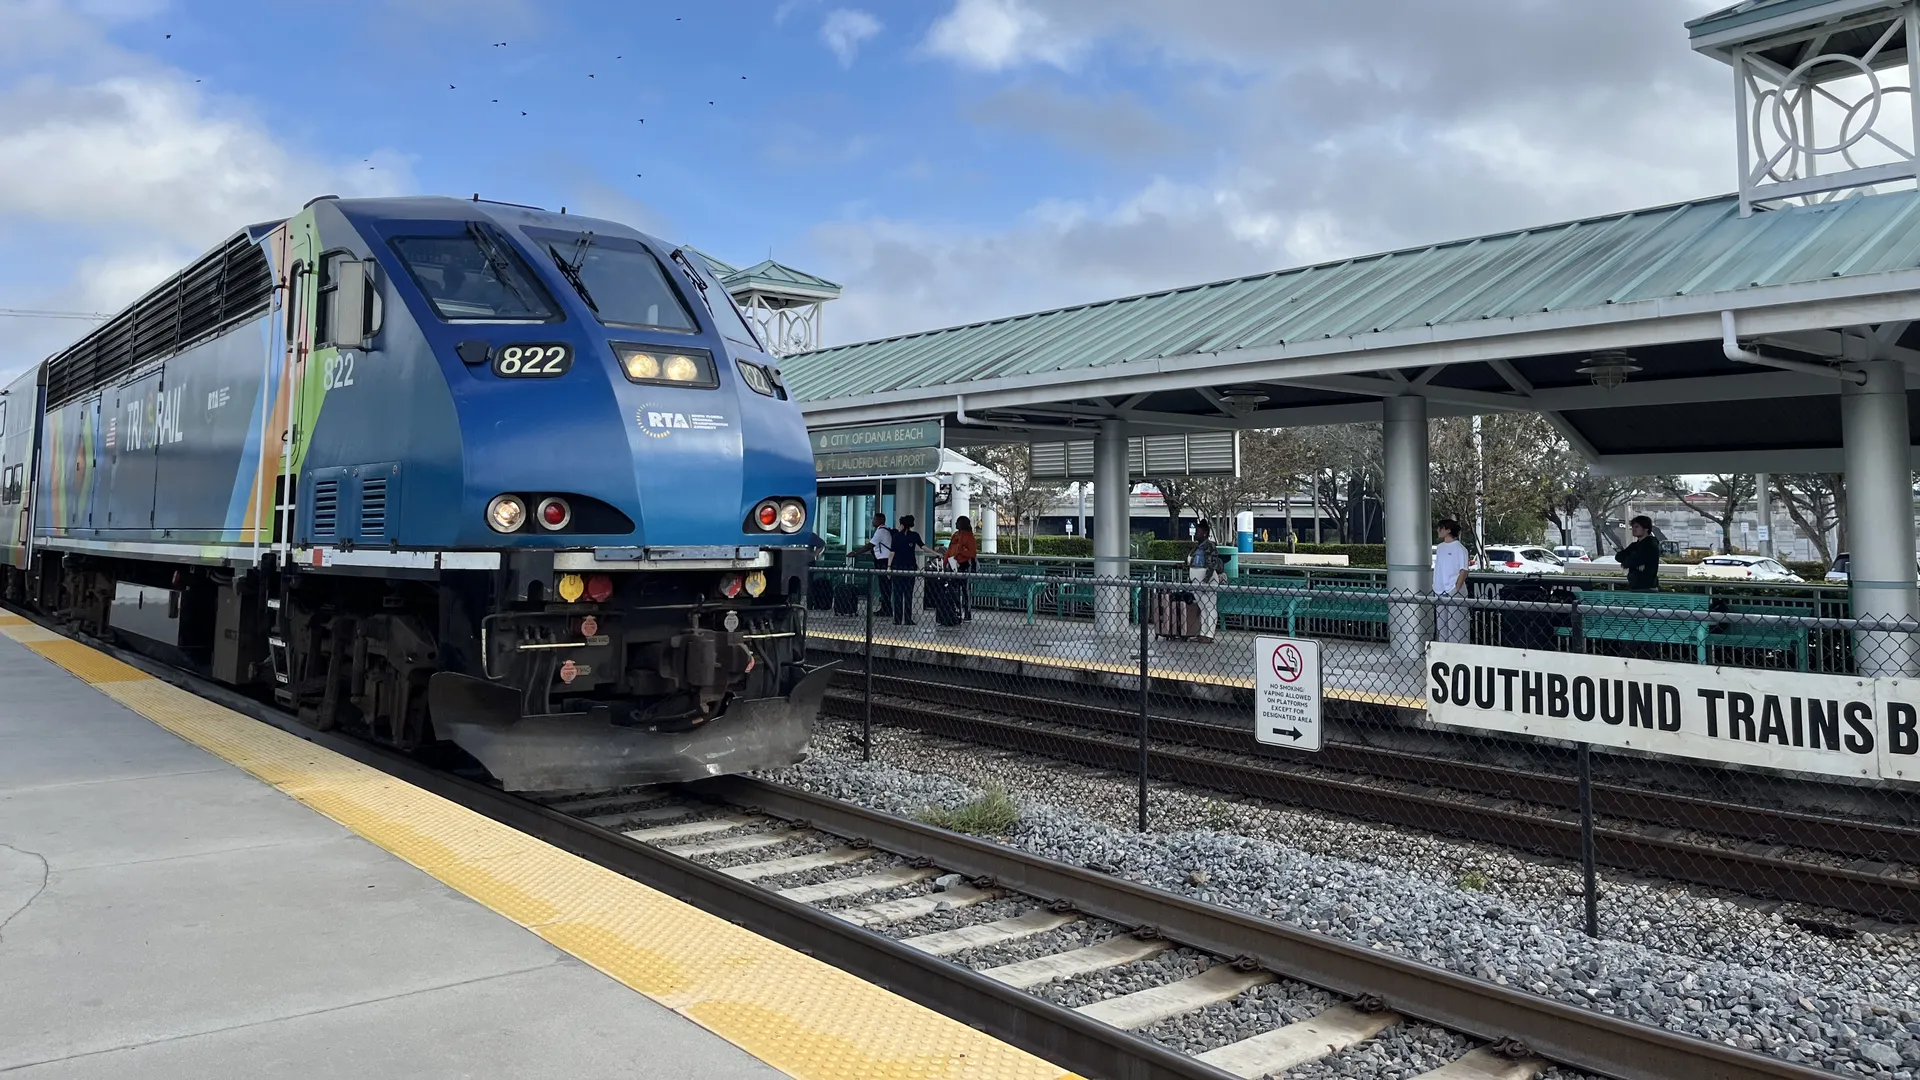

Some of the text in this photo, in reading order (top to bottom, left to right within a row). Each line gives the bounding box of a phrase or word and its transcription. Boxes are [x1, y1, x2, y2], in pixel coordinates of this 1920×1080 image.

[500, 346, 566, 374] 822
[324, 352, 354, 391] 822
[126, 386, 183, 451] TRI RAIL
[648, 412, 690, 429] RTA
[831, 427, 924, 446] CITY OF DANIA BEACH
[826, 453, 926, 471] FT. LAUDERDALE AIRPORT
[1277, 699, 1308, 708] PLATFORMS
[1286, 693, 1312, 701] ALLOWED
[1263, 711, 1297, 721] DESIGNATED
[1431, 662, 1919, 755] SOUTHBOUND TRAINS B
